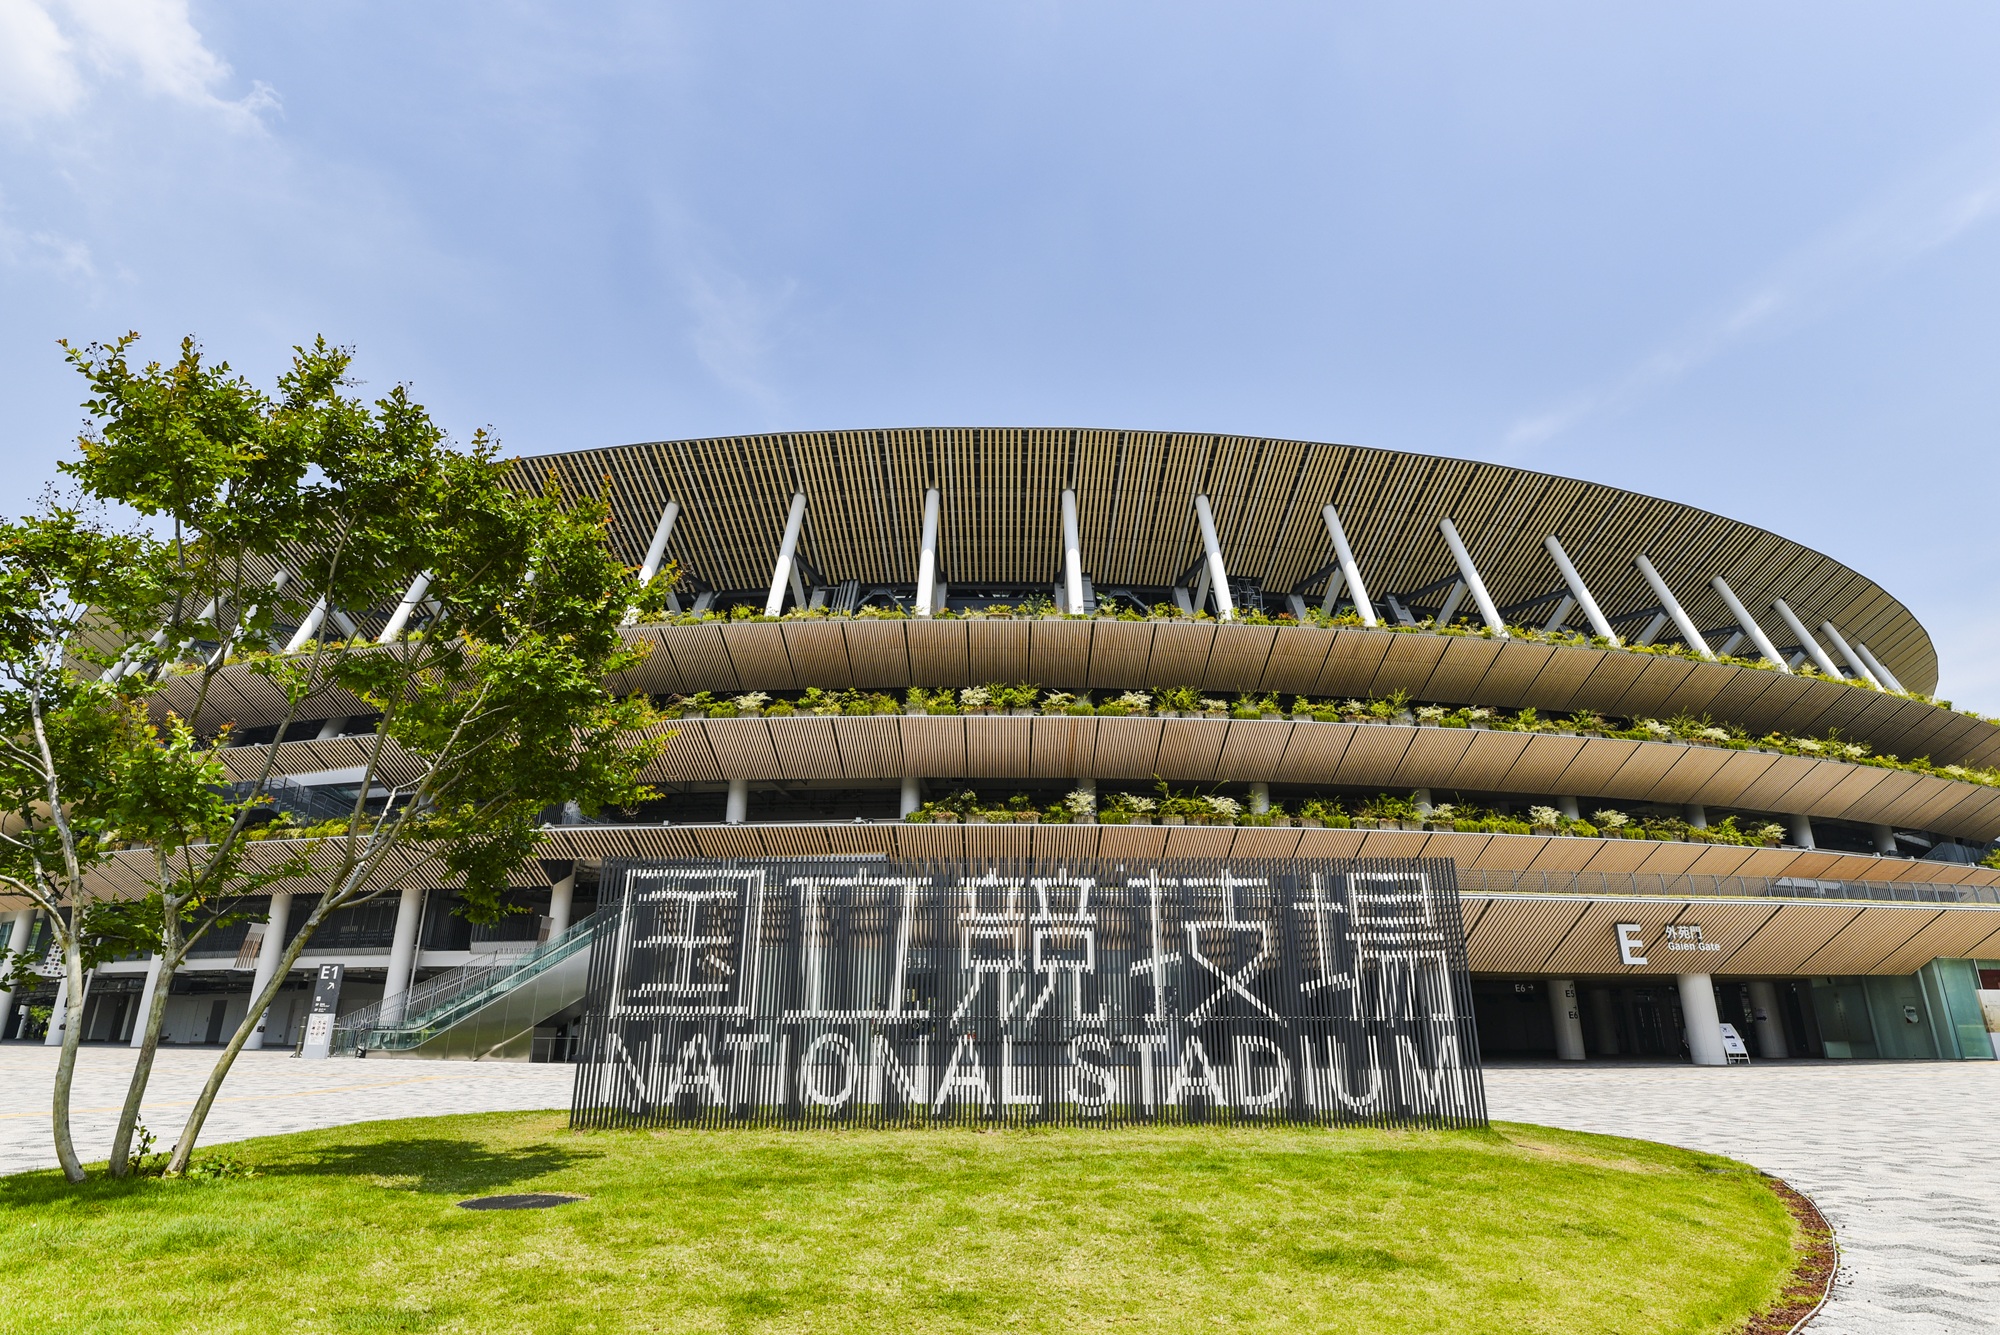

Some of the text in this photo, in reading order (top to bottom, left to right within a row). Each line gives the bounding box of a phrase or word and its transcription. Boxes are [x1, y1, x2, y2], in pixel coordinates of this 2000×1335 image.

[1665, 925, 1703, 940] 外苑門
[610, 867, 1457, 1028] 国立競技場
[1615, 923, 1648, 965] E
[1668, 942, 1721, 951] Gaien Gate
[320, 965, 339, 980] E1
[1514, 984, 1526, 993] E6
[1565, 990, 1575, 998] E5
[1568, 1011, 1579, 1019] E6
[600, 1032, 1466, 1118] NATIONAL STADIUM
